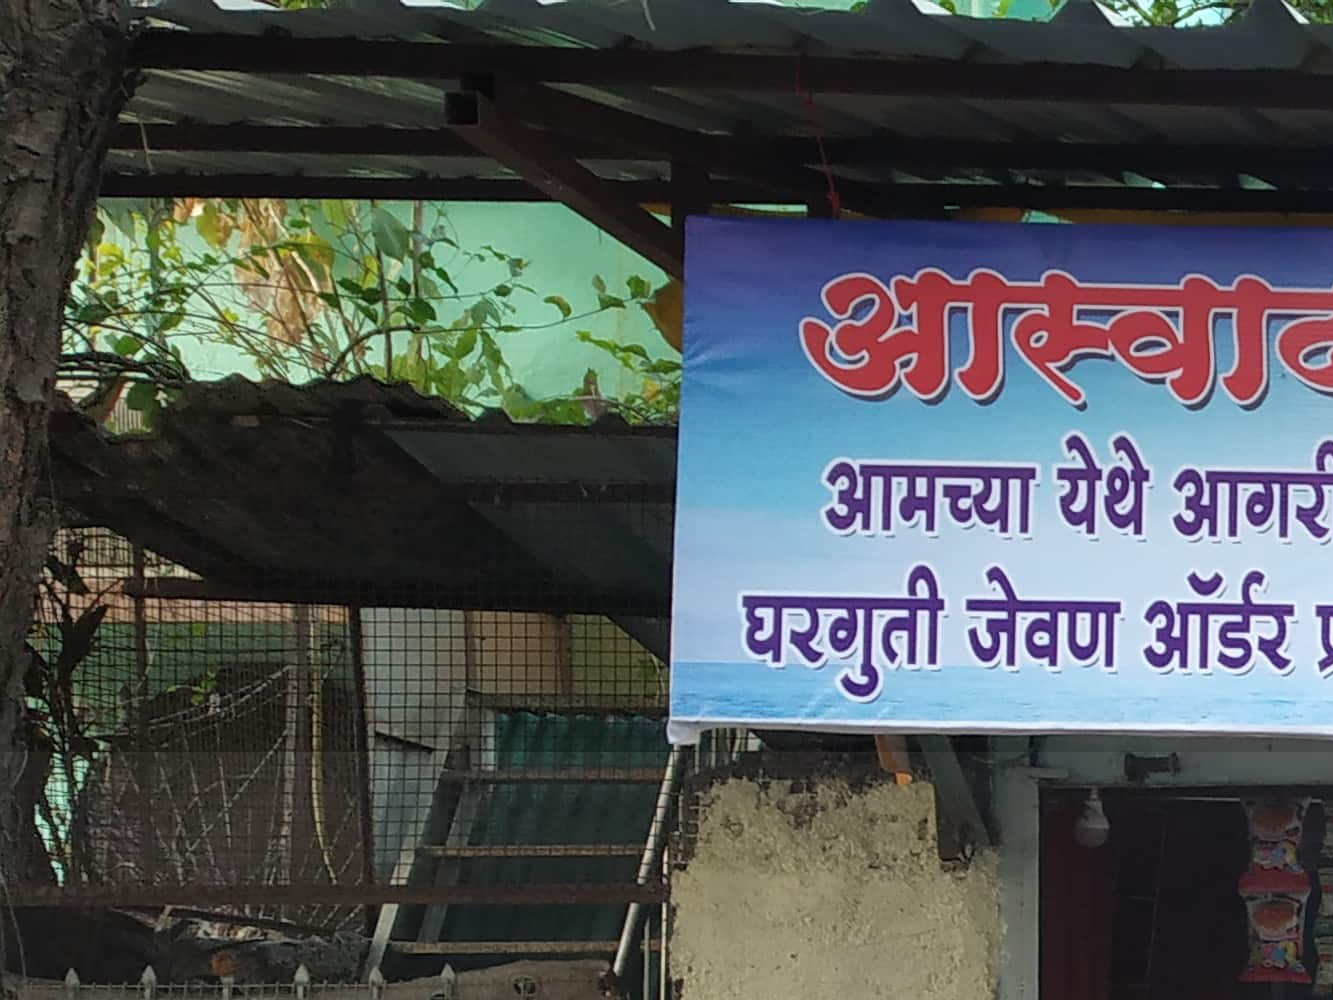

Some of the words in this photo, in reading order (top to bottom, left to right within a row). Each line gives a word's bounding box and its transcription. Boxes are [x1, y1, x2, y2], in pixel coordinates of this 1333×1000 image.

[826, 461, 1037, 535] आमच्या
[1058, 436, 1150, 536] येथे
[744, 565, 946, 697] घरगुती
[967, 566, 1121, 668] जेवण
[1144, 571, 1295, 671] ऑर्डर
